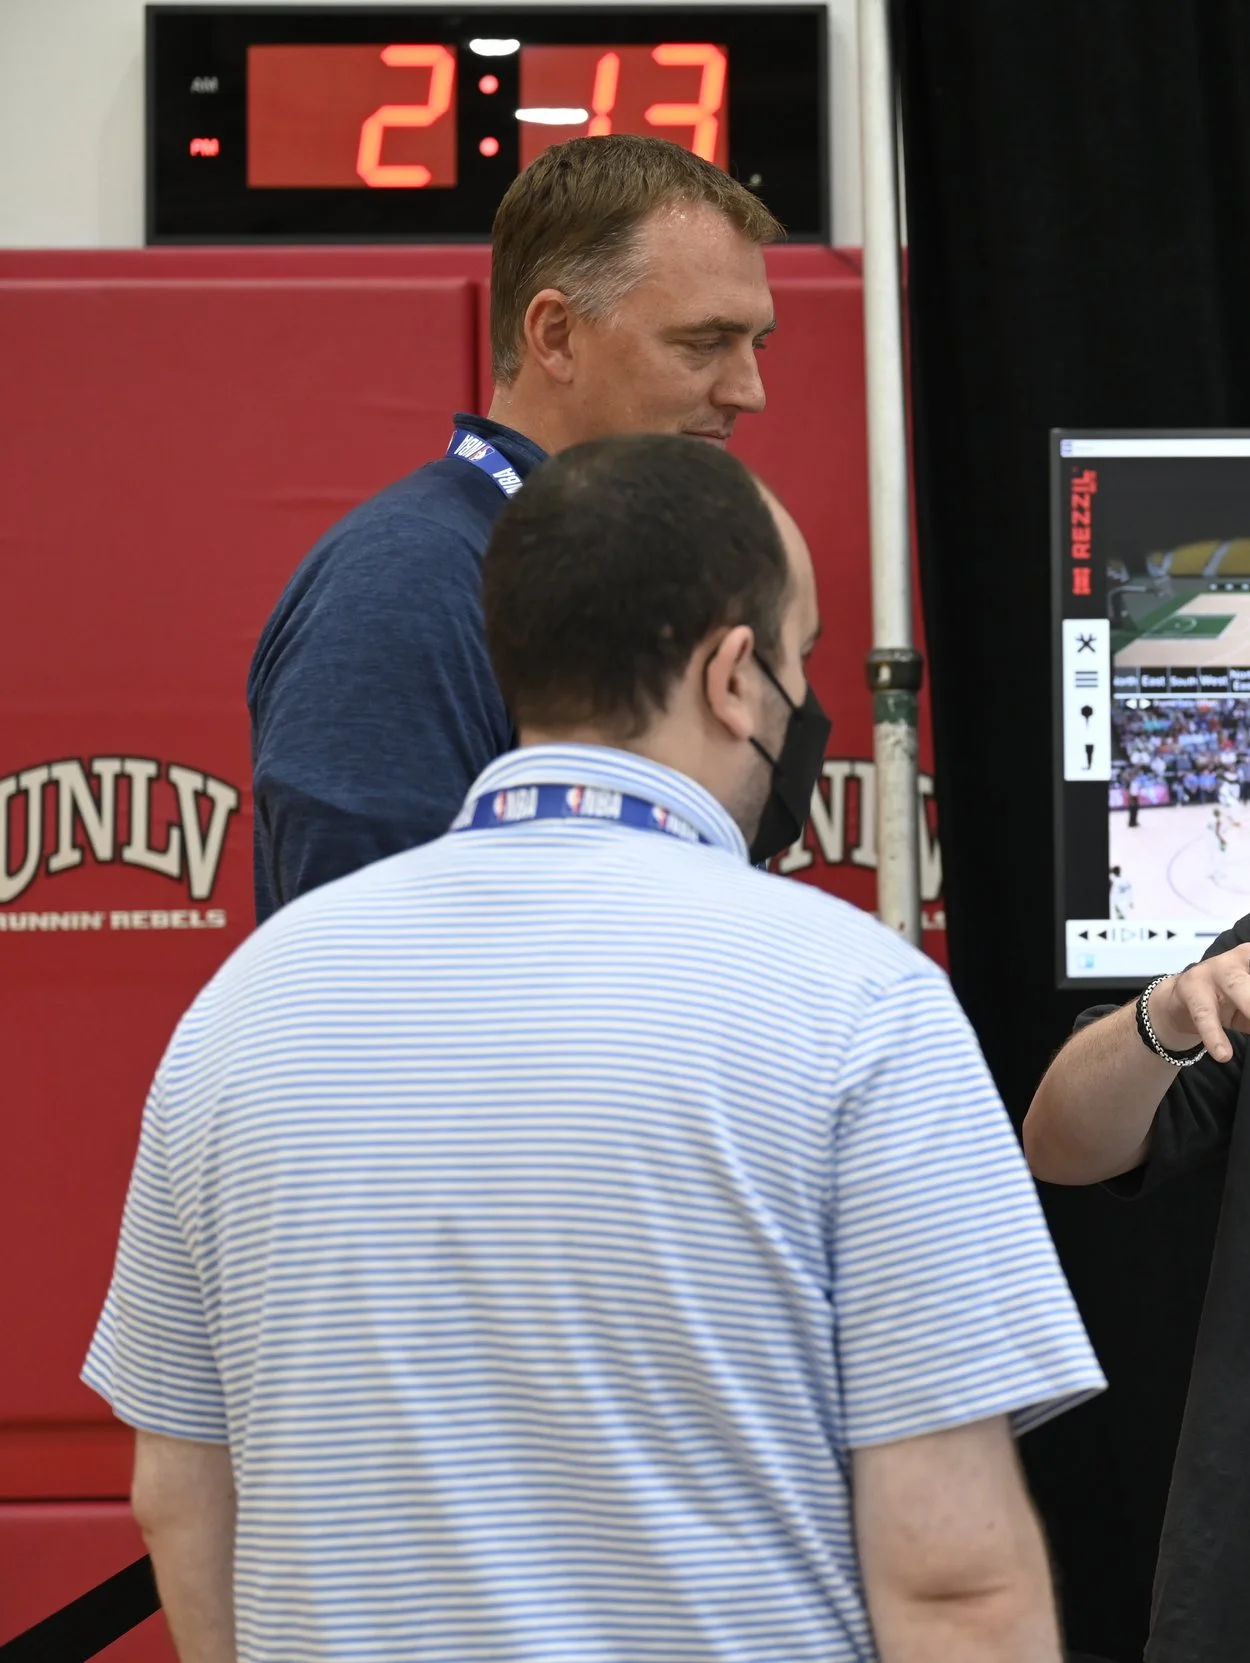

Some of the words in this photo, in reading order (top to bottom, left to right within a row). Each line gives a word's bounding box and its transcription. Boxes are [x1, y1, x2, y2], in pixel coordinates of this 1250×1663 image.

[189, 137, 220, 157] PM
[453, 433, 487, 459] NBA
[1071, 469, 1098, 560] REZZIL
[1142, 675, 1166, 687] East
[1169, 675, 1198, 687] South
[1199, 675, 1228, 687] West
[0, 754, 239, 903] UNLV
[109, 908, 227, 930] REBELS
